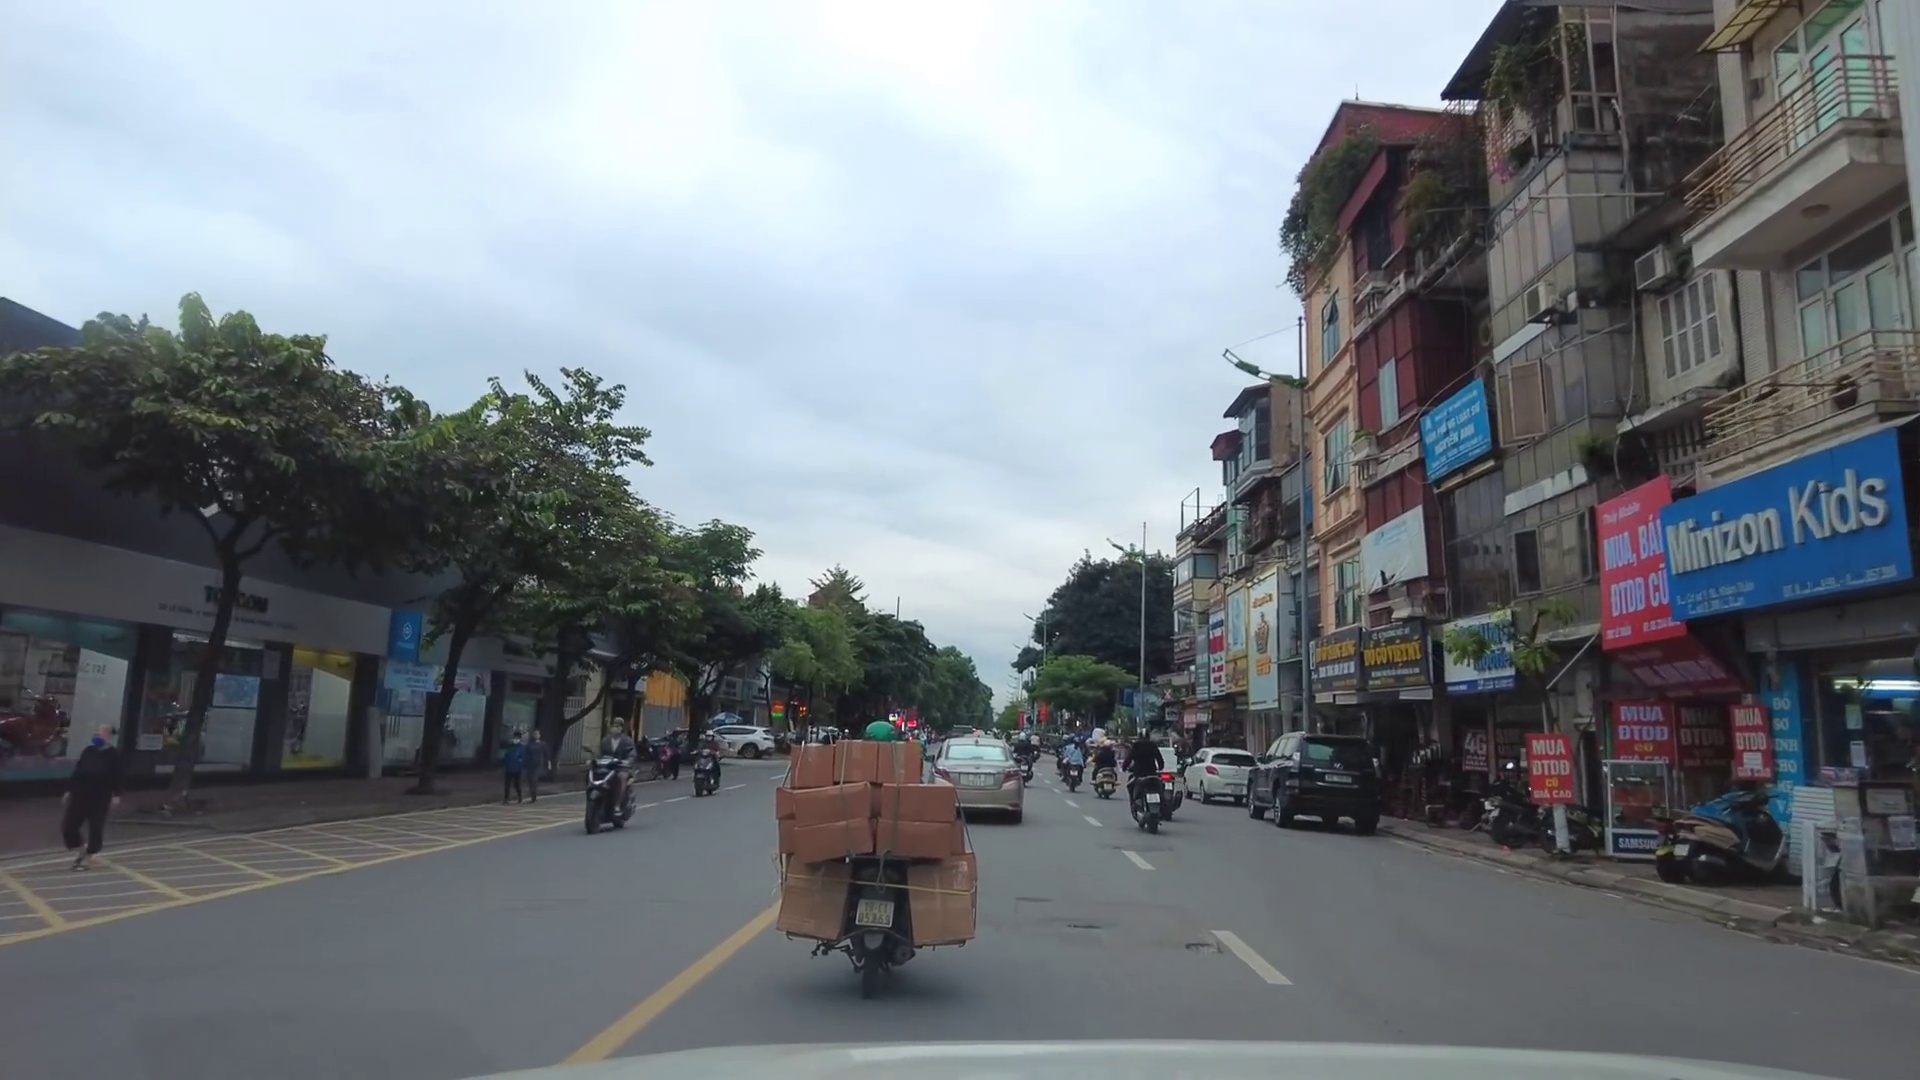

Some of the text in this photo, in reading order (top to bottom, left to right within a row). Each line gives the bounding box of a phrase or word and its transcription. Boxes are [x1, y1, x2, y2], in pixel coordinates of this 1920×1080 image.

[1667, 468, 1890, 575] Minizon Kids
[1620, 706, 1664, 721] MUA
[1735, 708, 1762, 726] MUA
[1465, 732, 1487, 755] 4G
[1532, 740, 1565, 755] MUA
[1534, 789, 1571, 798] GIÁ CAO
